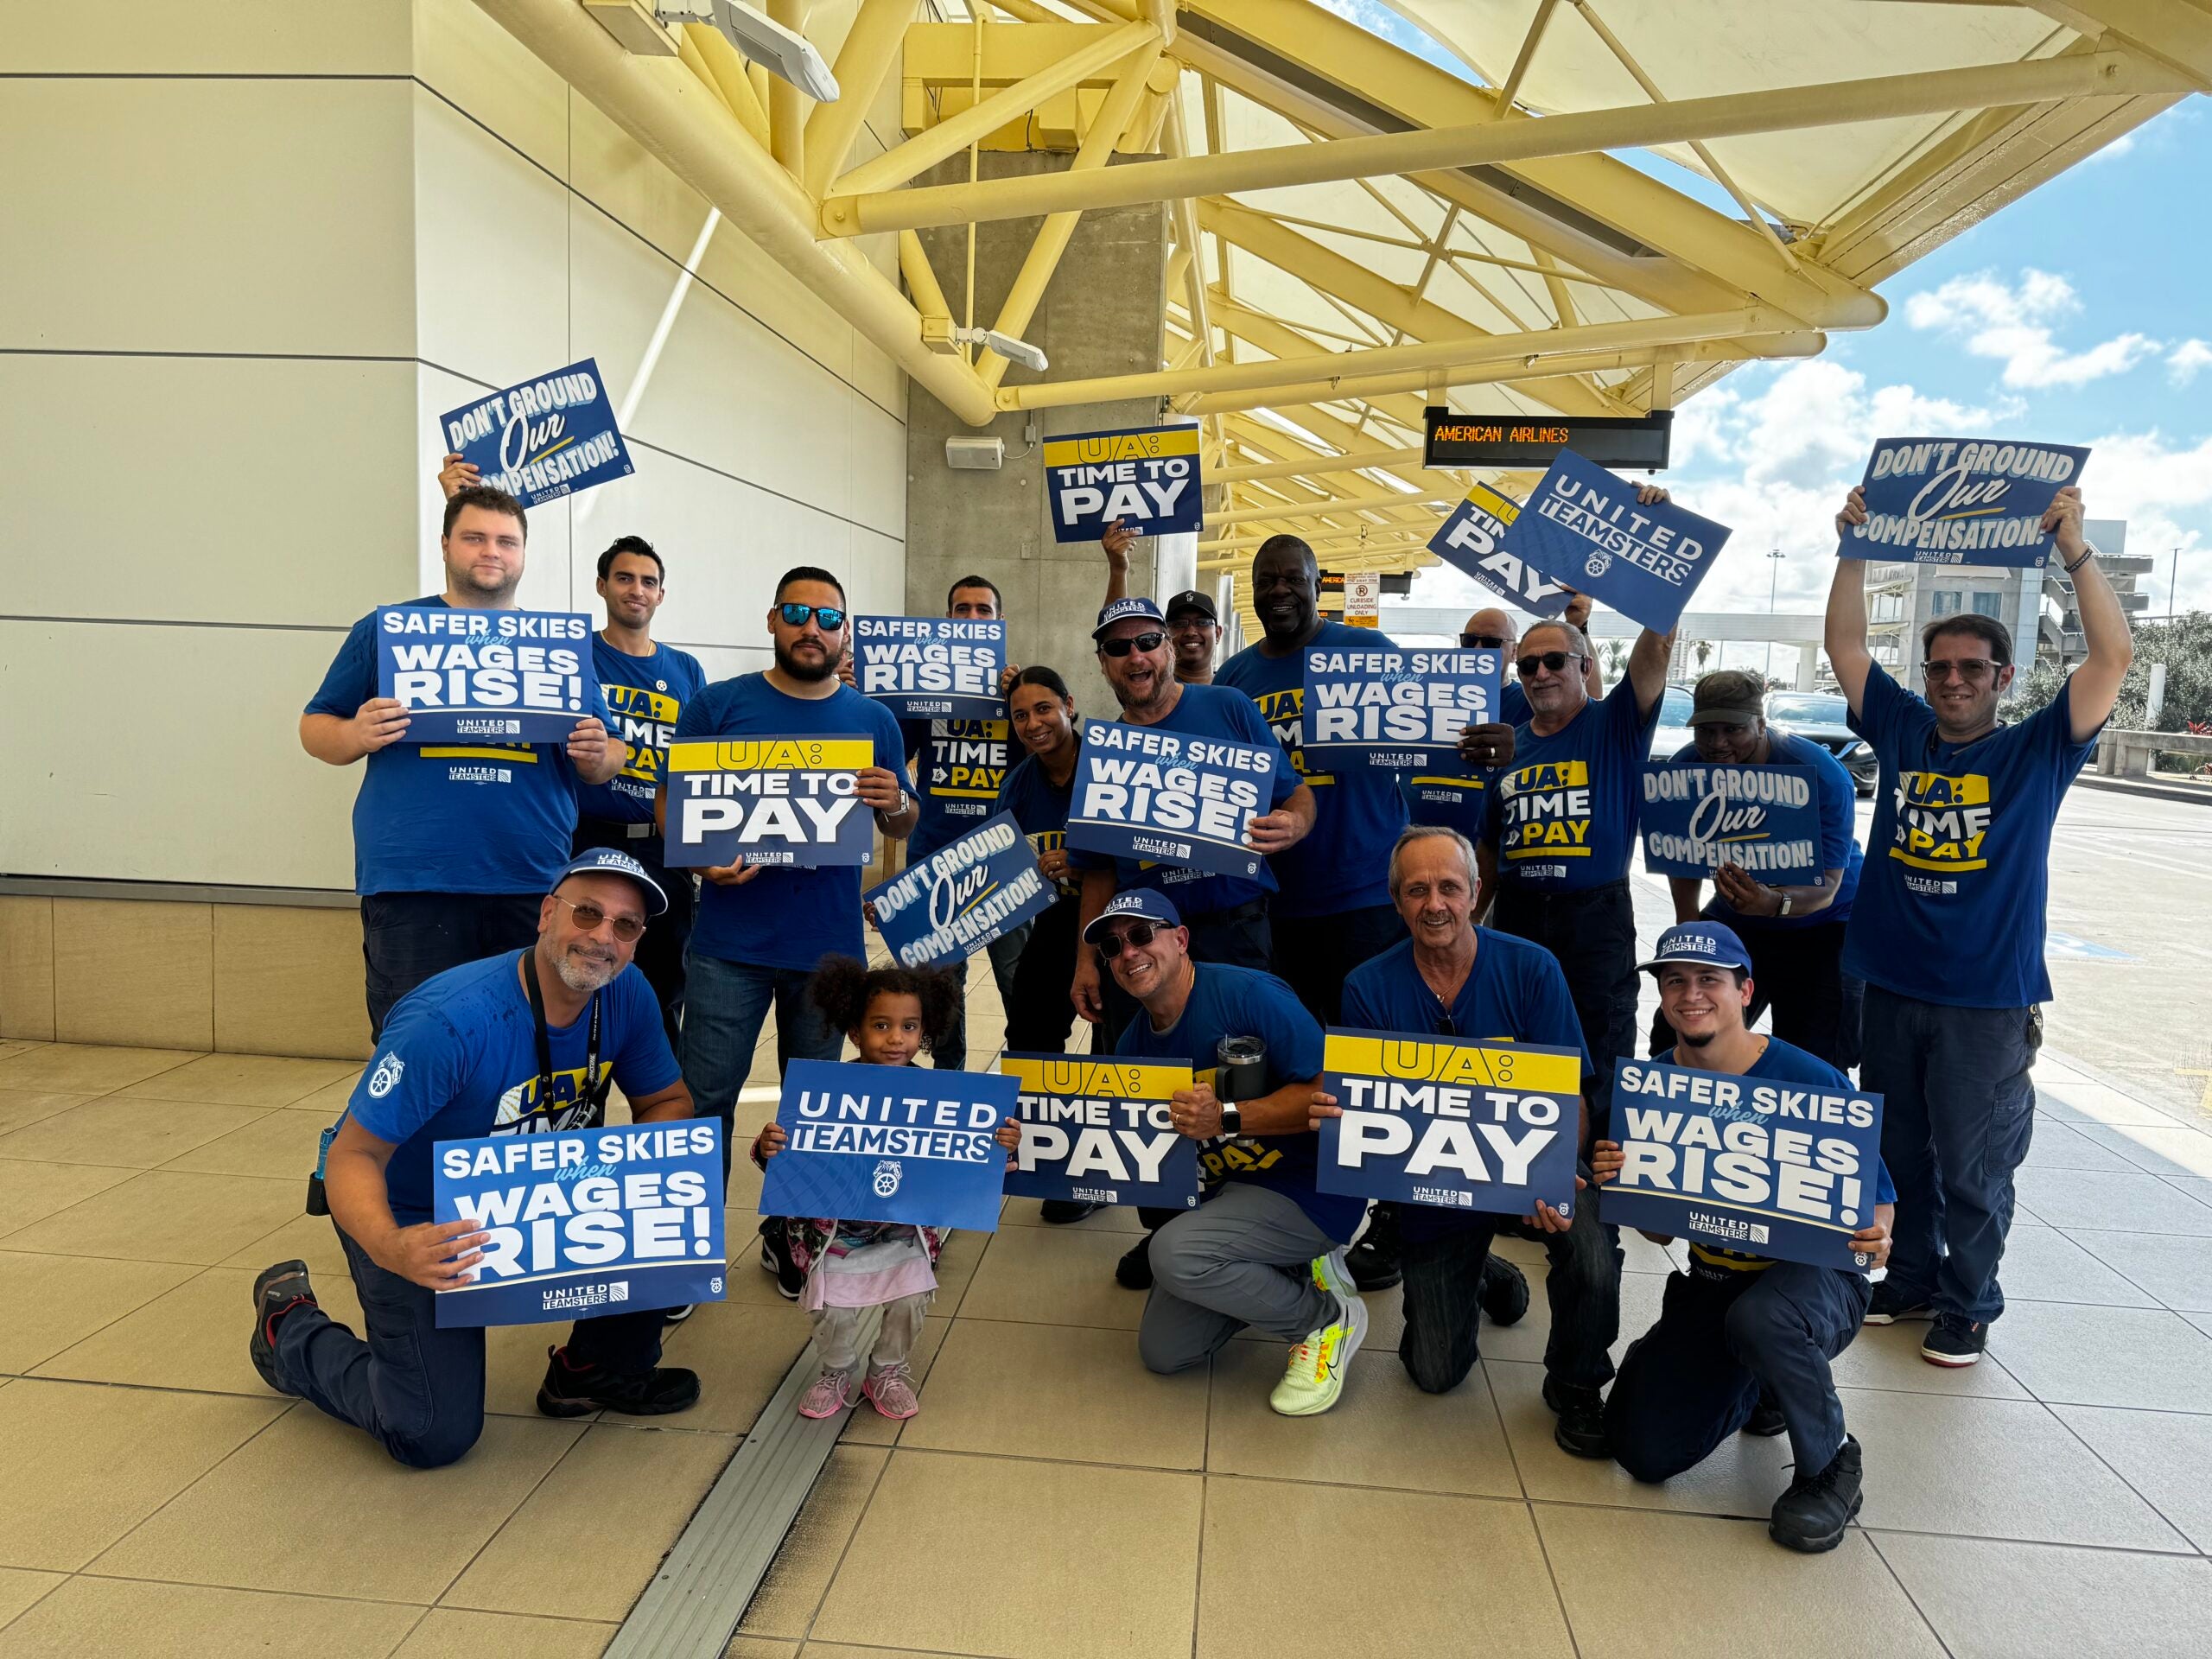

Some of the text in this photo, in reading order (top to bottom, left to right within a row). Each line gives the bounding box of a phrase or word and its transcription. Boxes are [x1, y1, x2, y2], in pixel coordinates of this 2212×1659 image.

[448, 372, 597, 450] DON'T GROUND
[499, 412, 566, 473] Our
[1434, 425, 1568, 443] AMERICAN AIRLINES
[480, 430, 619, 497] MPENSATION!
[1077, 435, 1160, 464] UA:
[1872, 442, 2074, 483] DON'T GROUND
[1058, 458, 1190, 487] TIME TO
[531, 486, 560, 499] UNITED
[1059, 479, 1190, 525] PAY
[1908, 463, 2011, 522] Our
[1555, 474, 1703, 561] UNITED
[1537, 493, 1694, 587] TEAMSTERS
[1446, 518, 1566, 603] PAY
[384, 612, 586, 639] SAFER SKIES
[465, 628, 512, 646] when
[858, 620, 1001, 640] SAFER SKIES
[914, 632, 948, 645] when
[391, 645, 579, 675] WAGES
[863, 644, 995, 668] WAGES
[1309, 653, 1495, 675] SAFER SKIES
[864, 663, 998, 696] RISE!
[1380, 665, 1424, 683] when
[394, 669, 582, 711] RISE!
[608, 689, 664, 718] UA:
[1315, 682, 1487, 710] WAGES
[612, 716, 676, 747] IME
[947, 719, 993, 738] UA:
[716, 741, 823, 770] UA:
[931, 741, 1007, 766] TIME
[1088, 726, 1180, 758] SAFER
[1187, 741, 1271, 772] SKIES
[1155, 752, 1198, 771] when
[448, 773, 496, 782] TEAMSTERS
[684, 772, 859, 796] TIME TO
[951, 766, 1007, 789] PAY
[1090, 758, 1258, 807] WAGES
[1515, 766, 1569, 791] UA:
[1643, 769, 1809, 808] DON'T GROUND
[1908, 775, 1964, 804] UA:
[683, 798, 858, 843] PAY
[1083, 783, 1257, 845] RISE!
[1505, 790, 1591, 824] TIME
[1689, 790, 1766, 843] Our
[1134, 836, 1176, 849] UNITED
[1523, 820, 1590, 845] PAY
[1909, 828, 1986, 858] PAY
[1133, 843, 1176, 855] TEAMSTERS
[1649, 832, 1815, 870] COMPENSATION!
[874, 823, 1016, 923] DON'T GROUND
[1162, 868, 1200, 878] UNITE
[929, 865, 988, 931] Our
[899, 867, 1043, 968] COMPENSATION!
[963, 931, 991, 951] UNITED
[1662, 935, 1716, 948] UNITED
[1382, 1039, 1514, 1087] UA:
[1042, 1060, 1141, 1098] UA:
[519, 1074, 577, 1115] UA
[798, 1091, 997, 1128] UNITED
[1341, 1078, 1560, 1126] TIME TO
[1621, 1066, 1874, 1128] SAFER SKIES
[1017, 1096, 1173, 1129] TIME TO
[1708, 1101, 1769, 1125] when
[443, 1126, 715, 1179] SAFER SKIES
[791, 1122, 992, 1163] TEAMSTERS
[1018, 1123, 1180, 1183] PAY
[1338, 1109, 1558, 1185] PAY
[1625, 1108, 1859, 1175] WAGES
[554, 1155, 616, 1181] when
[1414, 1186, 1458, 1197] UNITED
[1619, 1141, 1861, 1226] RISE!
[454, 1171, 707, 1228] WAGES
[1413, 1193, 1458, 1205] TEAMSTERS
[1689, 1222, 1748, 1241] TEAMSTERS
[1690, 1211, 1749, 1230] UNITED
[457, 1207, 711, 1282] RISE!
[543, 1284, 607, 1300] UNITED
[543, 1294, 607, 1310] TEAMSTERS
